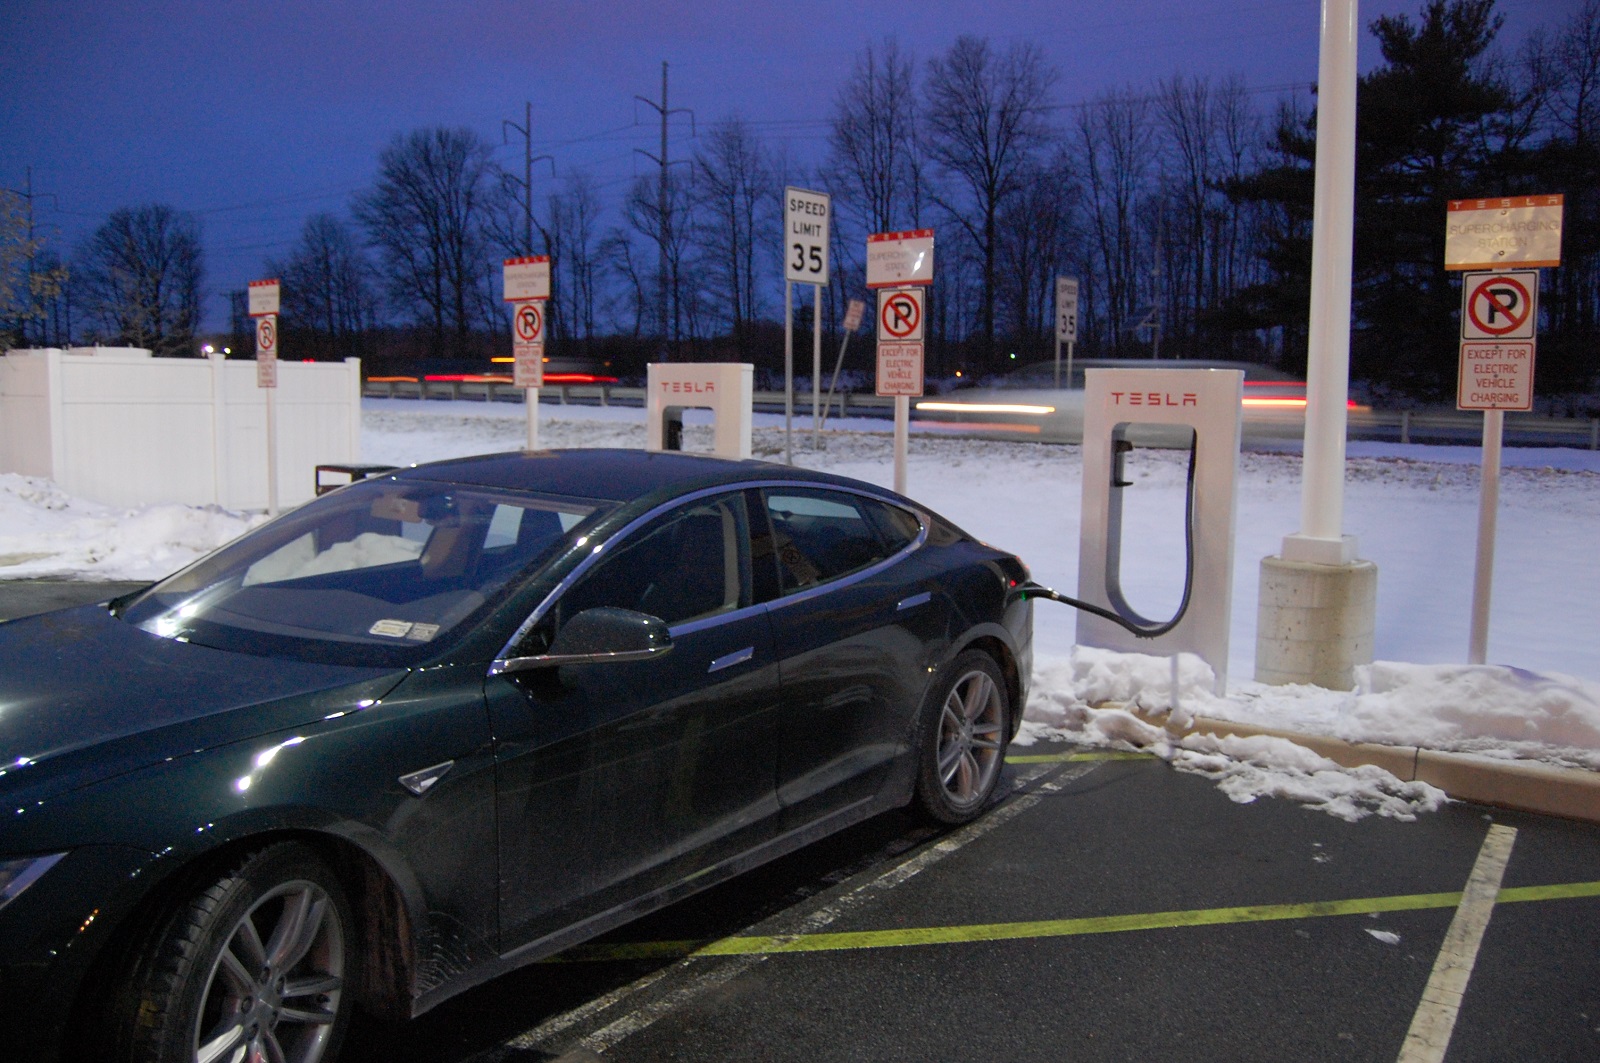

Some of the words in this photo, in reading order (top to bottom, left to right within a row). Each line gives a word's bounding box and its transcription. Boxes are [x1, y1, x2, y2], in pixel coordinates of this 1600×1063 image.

[790, 199, 826, 217] SPEED
[1452, 196, 1558, 210] TESLA
[793, 221, 822, 238] LIMIT
[1449, 219, 1560, 235] SUPERCHARGING
[1478, 237, 1528, 249] STATION
[791, 243, 823, 273] 35
[1061, 314, 1075, 335] 35
[881, 348, 904, 357] EXCEPT
[906, 348, 919, 357] FOR
[1467, 349, 1503, 360] EXCEPT
[1507, 349, 1526, 360] FOR
[886, 360, 914, 368] ELECTRIC
[1473, 363, 1519, 374] ELECTRIC
[887, 371, 912, 379] VEHICLE
[661, 382, 715, 393] TESLA
[884, 382, 915, 390] CHARGING
[1476, 378, 1516, 389] VEHICLE
[1111, 392, 1197, 407] TESLA
[1470, 392, 1520, 404] CHARGING
